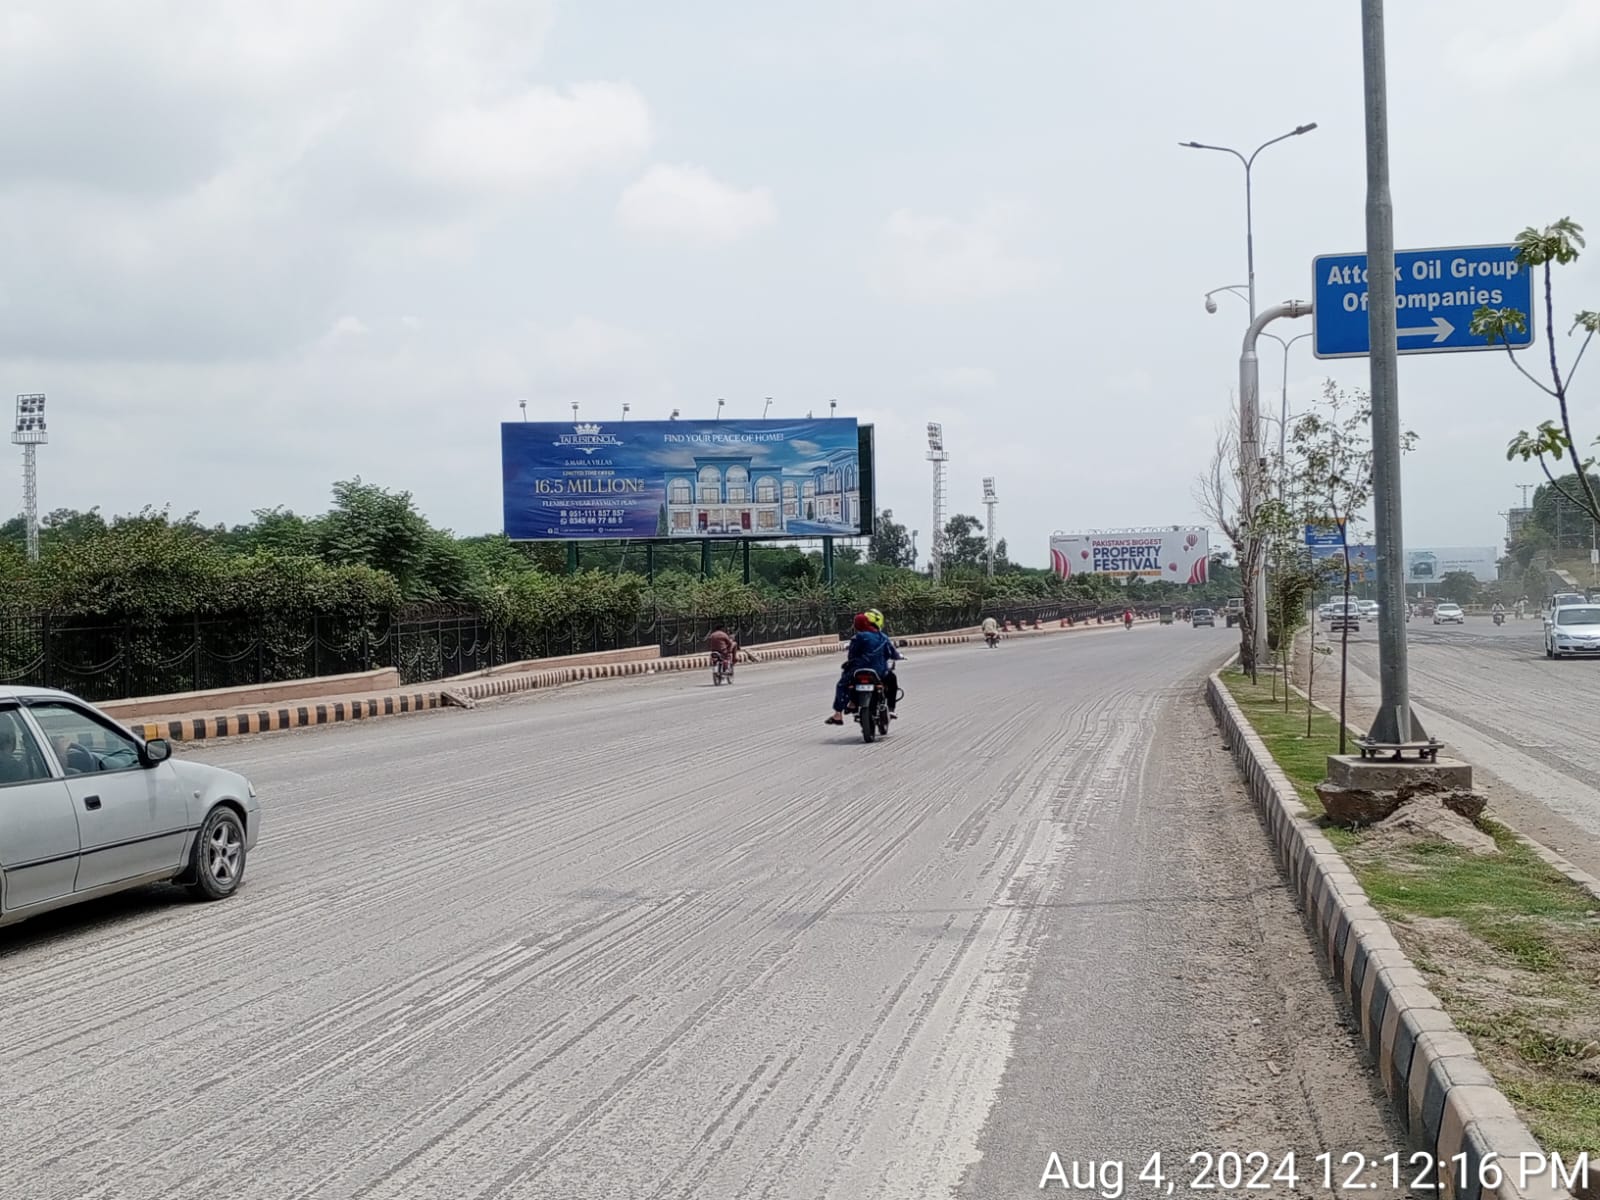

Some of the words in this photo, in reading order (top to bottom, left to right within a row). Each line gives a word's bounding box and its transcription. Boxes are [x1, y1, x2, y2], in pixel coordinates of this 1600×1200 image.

[1412, 259, 1441, 280] Oil
[1451, 257, 1518, 281] Group
[1342, 293, 1368, 312] Of
[1395, 286, 1503, 311] ompanies
[572, 435, 616, 444] RESIDENCIA
[664, 433, 685, 442] FIND
[685, 433, 711, 442] YOUR
[712, 433, 741, 441] PEACE
[741, 433, 754, 441] OF
[755, 432, 784, 441] HOME!
[535, 479, 564, 494] 16.5
[567, 478, 638, 493] MILLION
[598, 517, 606, 525] 77
[1092, 539, 1131, 547] PAKISTAN'S
[1132, 538, 1162, 546] BIGGEST
[1093, 545, 1161, 558] PROPERTY
[1094, 557, 1162, 571] FESTIVAL
